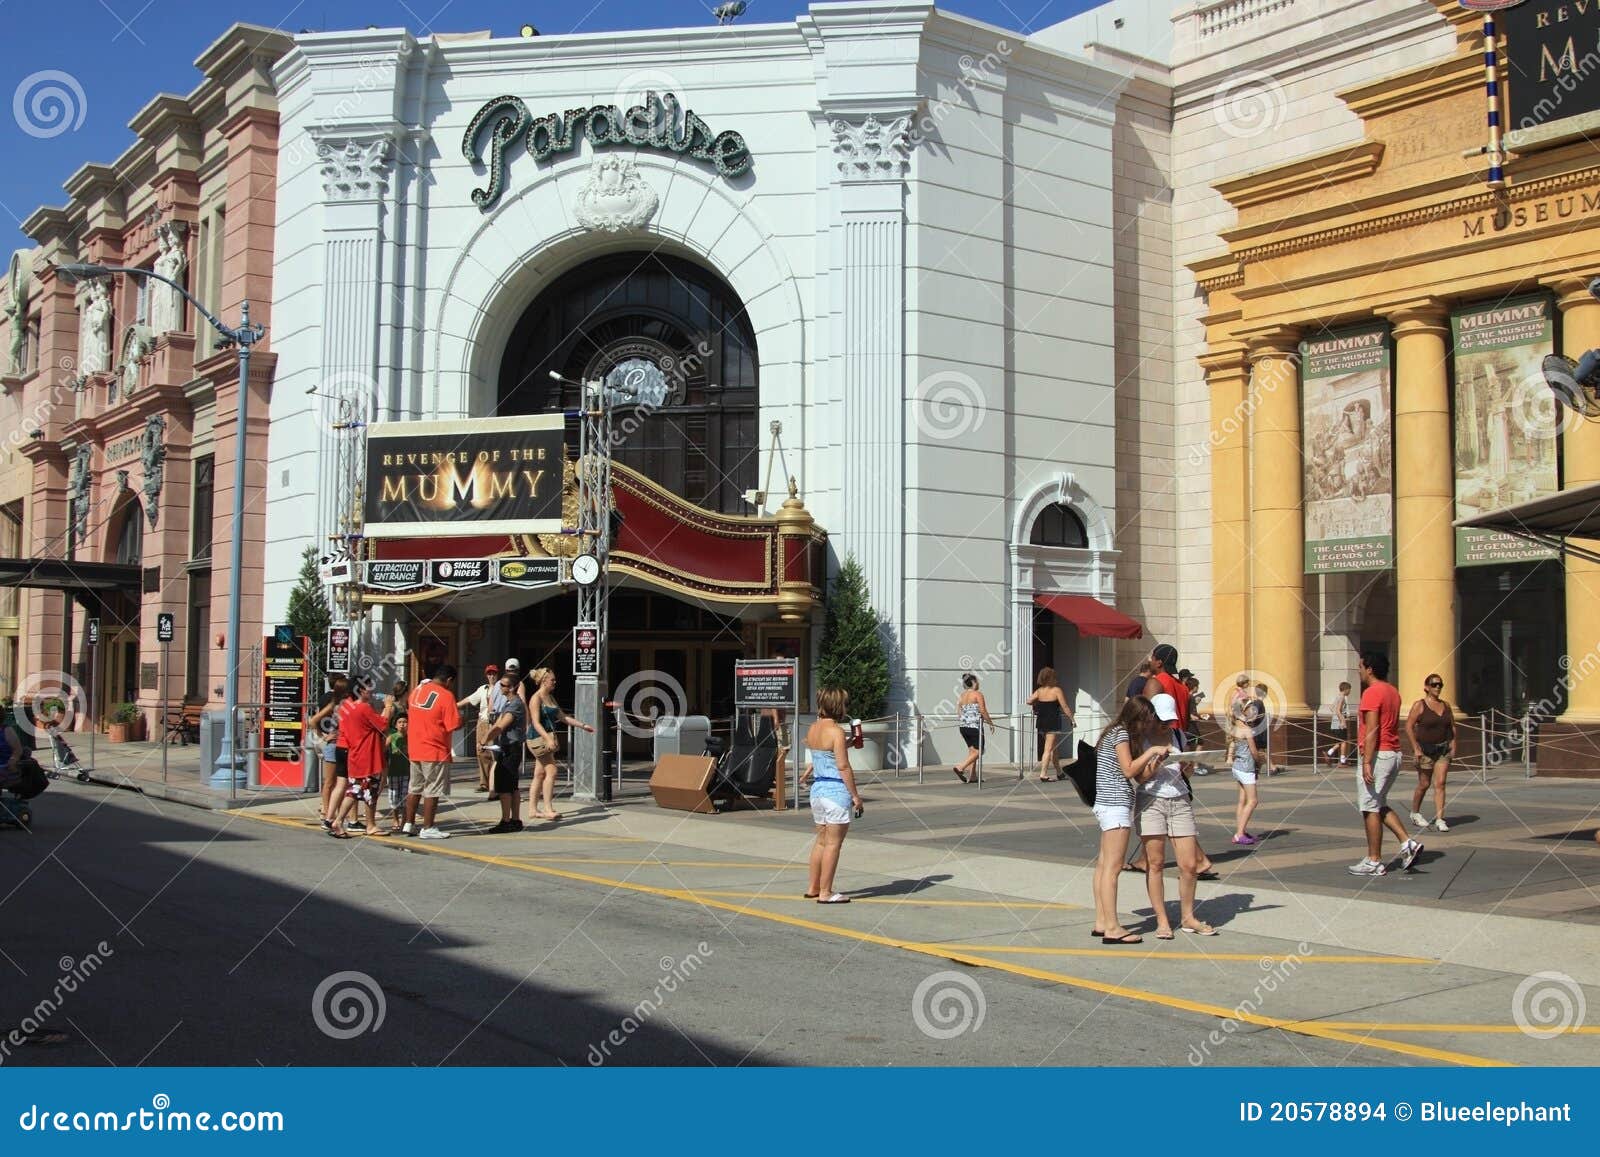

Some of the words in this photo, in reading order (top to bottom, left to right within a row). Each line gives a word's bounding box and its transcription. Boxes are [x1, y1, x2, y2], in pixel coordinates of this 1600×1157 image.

[1536, 0, 1600, 28] REV
[1539, 28, 1600, 81] M
[462, 90, 748, 212] Paradise
[1463, 192, 1600, 239] MUSEUM
[1460, 303, 1545, 329] MUMMY
[1476, 331, 1496, 339] THE
[1499, 323, 1545, 336] MUSEUM
[1309, 332, 1384, 356] MUMMY
[1478, 331, 1543, 347] ANTIQUITIES
[1342, 350, 1383, 362] MUSEUM
[1325, 358, 1381, 371] ANTIQUITIES
[383, 450, 468, 466] REVENGE
[479, 450, 501, 463] OF
[510, 448, 546, 461] THE
[381, 463, 545, 505] MUMMY
[1333, 542, 1373, 552] CURSES
[1471, 542, 1525, 551] LEGENDS
[1529, 540, 1542, 548] O
[1317, 551, 1363, 561] LEGENDS
[1464, 553, 1487, 561] THE
[1490, 549, 1553, 559] PHARAOHS
[372, 563, 419, 572] ATTRACTION
[453, 561, 481, 570] SINGLE
[1333, 559, 1386, 568] PHARAOHS
[374, 572, 416, 581] ENTRANCE
[453, 569, 481, 577] RIDERS
